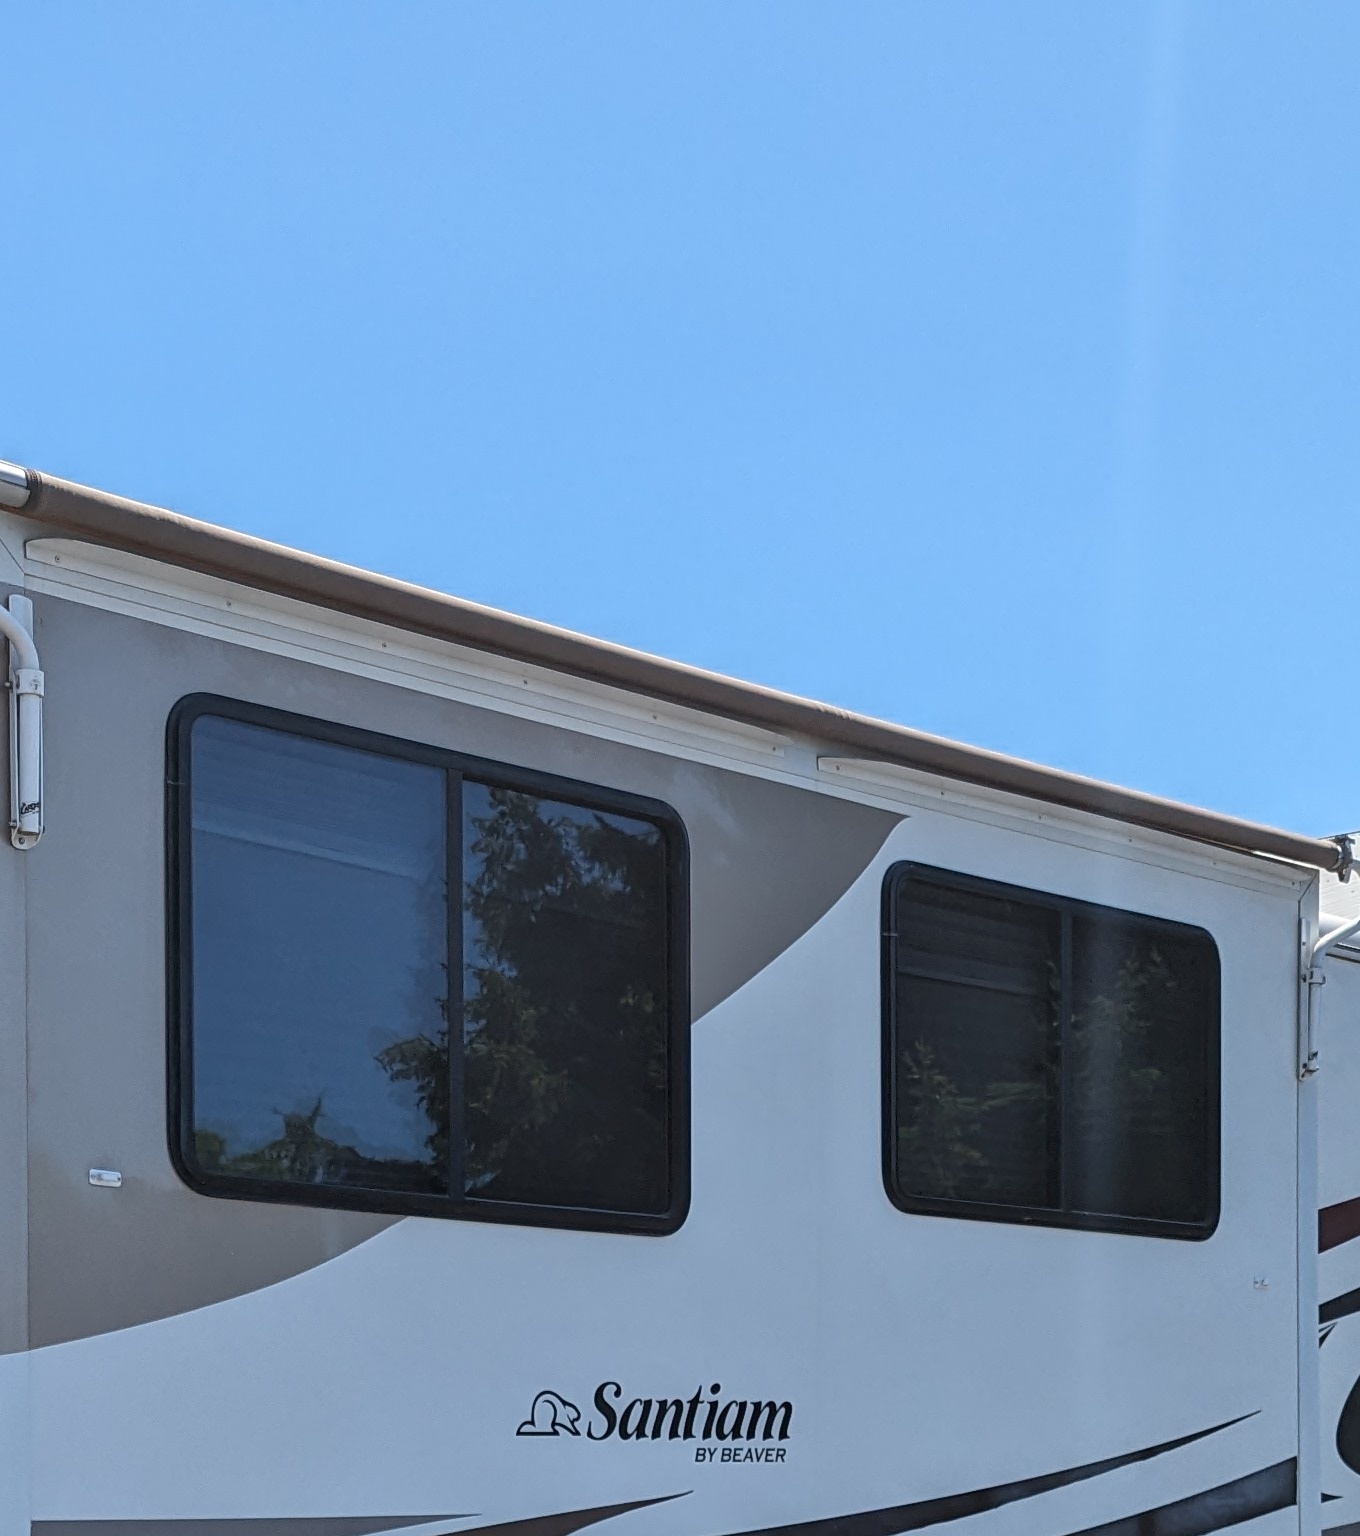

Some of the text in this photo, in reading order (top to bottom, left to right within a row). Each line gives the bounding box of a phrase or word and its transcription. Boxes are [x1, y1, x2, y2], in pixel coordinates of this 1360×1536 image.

[587, 1381, 793, 1441] Santiam
[694, 1447, 787, 1463] BY BEAVER
